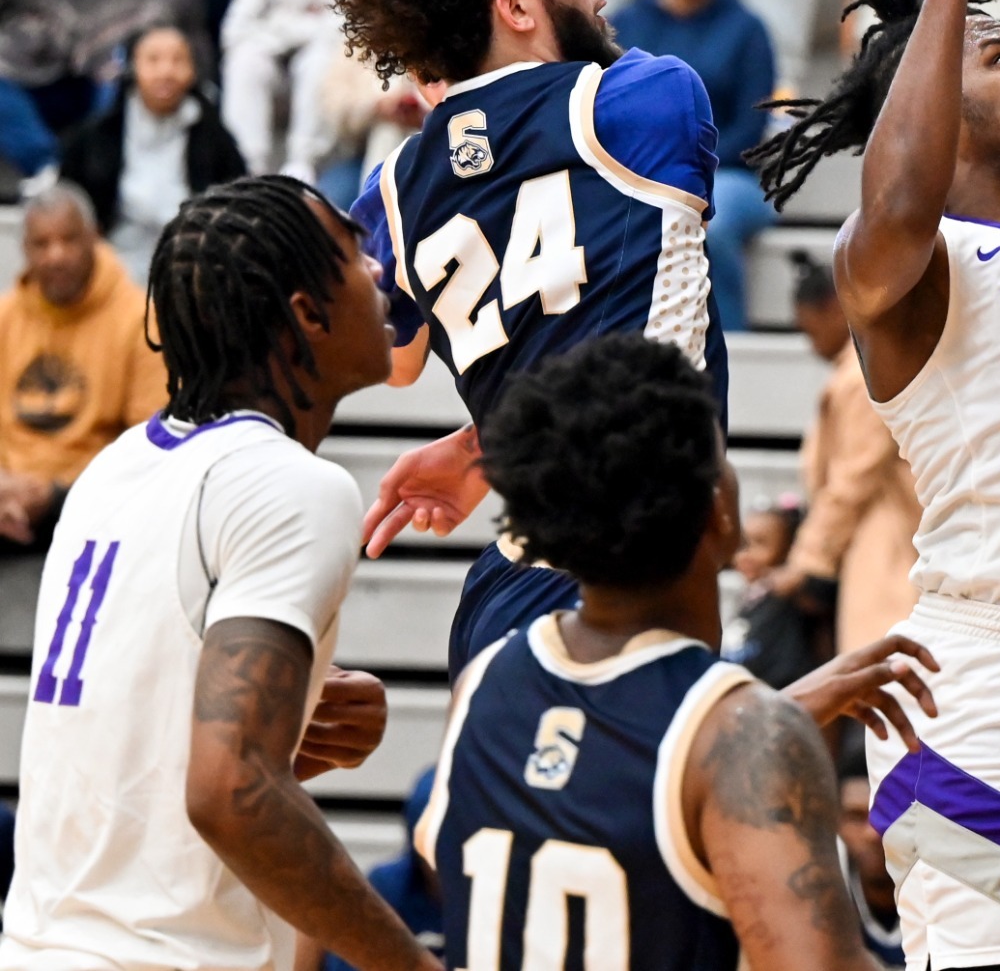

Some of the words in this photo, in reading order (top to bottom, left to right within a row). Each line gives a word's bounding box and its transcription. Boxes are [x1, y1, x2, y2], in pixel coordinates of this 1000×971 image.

[447, 108, 495, 178] S
[413, 168, 589, 376] 24
[33, 540, 121, 707] 11
[523, 705, 587, 791] S
[454, 827, 632, 971] 10
